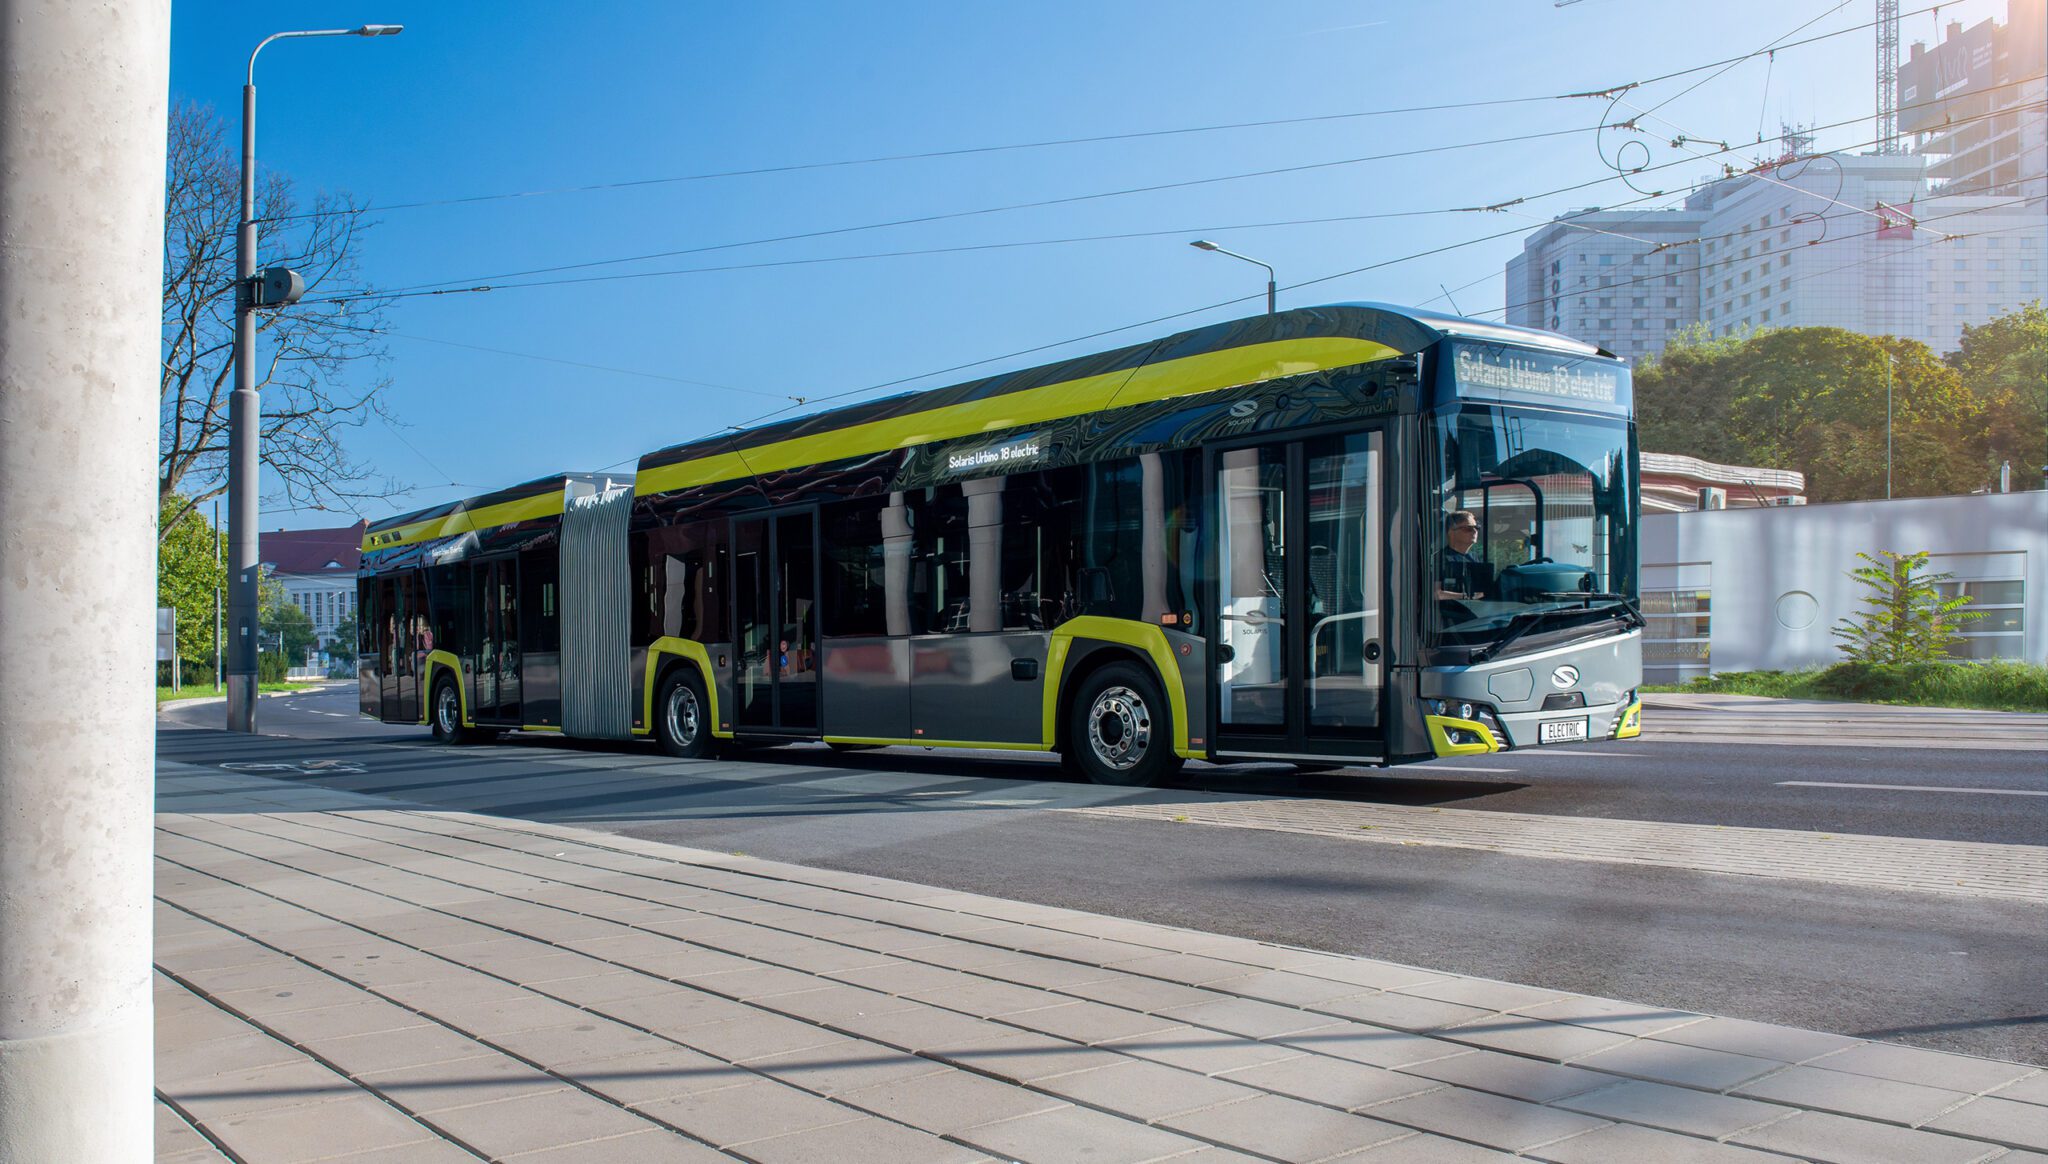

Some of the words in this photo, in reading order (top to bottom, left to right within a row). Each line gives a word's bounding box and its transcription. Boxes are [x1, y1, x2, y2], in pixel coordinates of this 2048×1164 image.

[1460, 351, 1508, 386] Solaris
[1509, 358, 1551, 392] Urbino
[1553, 365, 1569, 394] 18
[1571, 369, 1614, 401] electric
[949, 455, 975, 468] Solaris
[976, 450, 999, 464] Urbino
[1001, 447, 1010, 460] 18
[1010, 443, 1039, 459] electric
[1549, 722, 1580, 738] ELECTRIC
